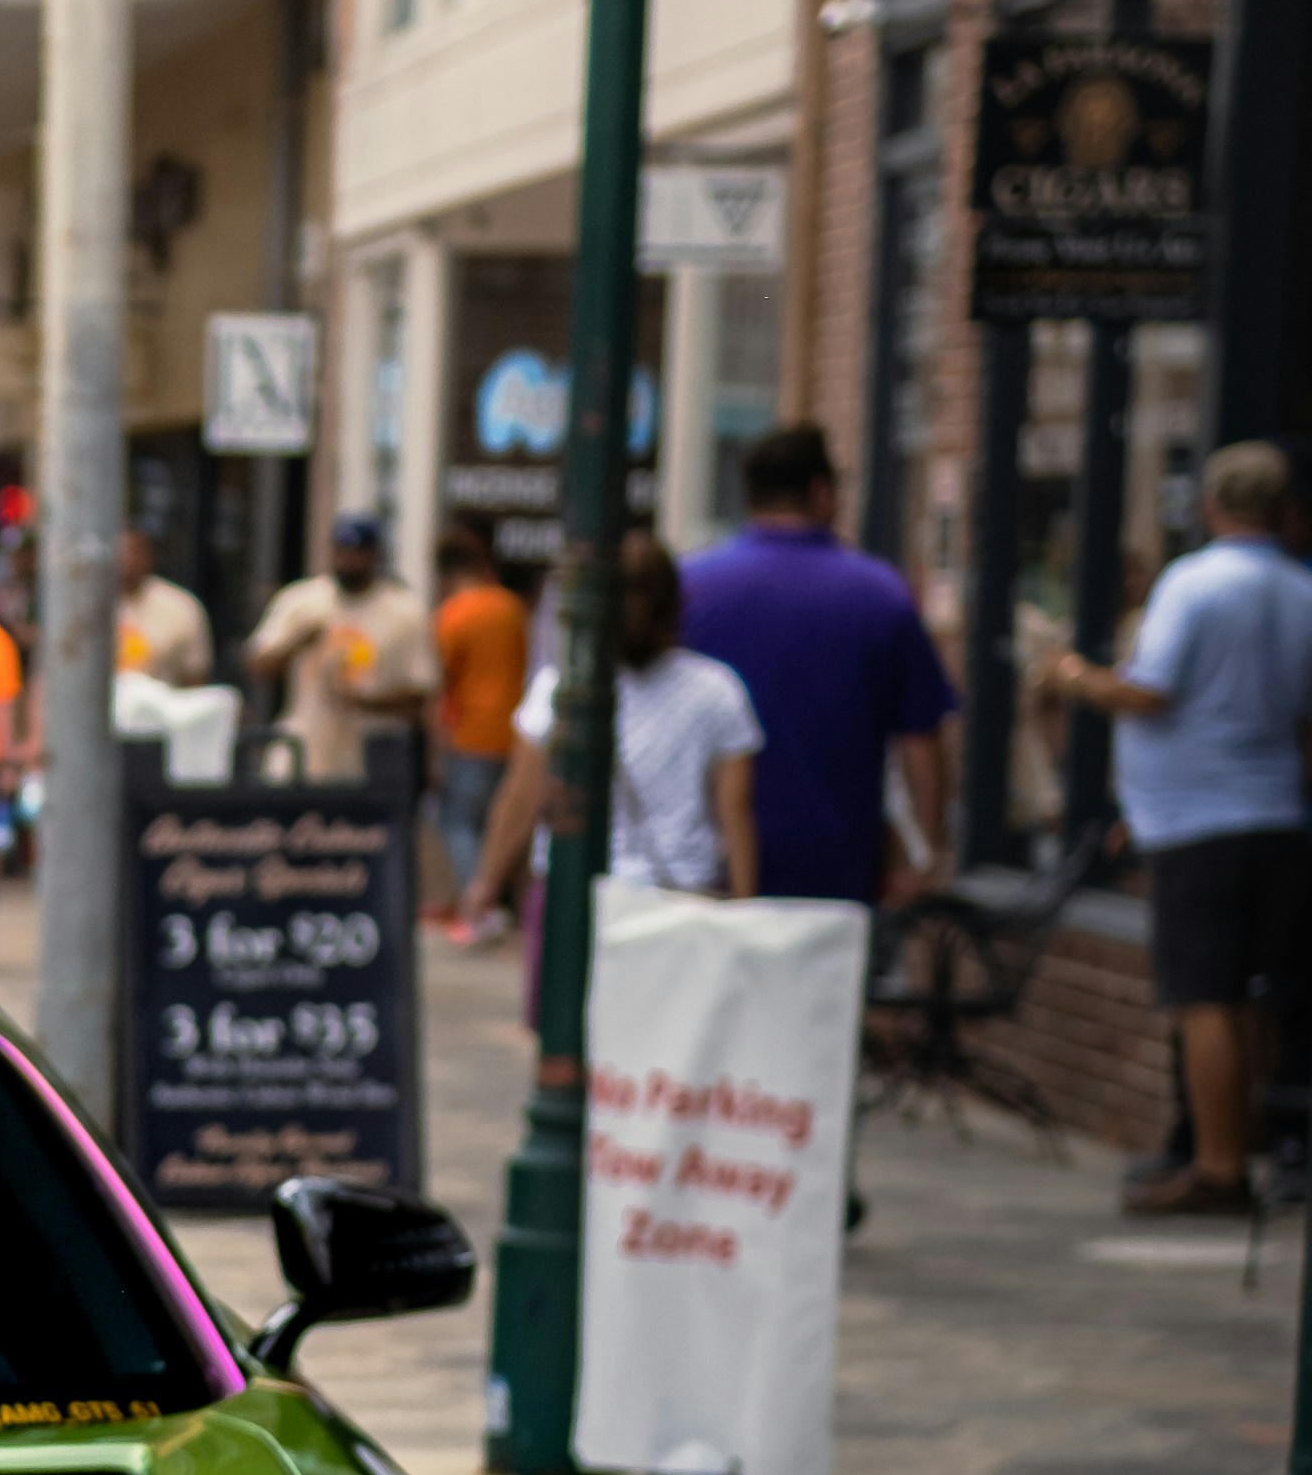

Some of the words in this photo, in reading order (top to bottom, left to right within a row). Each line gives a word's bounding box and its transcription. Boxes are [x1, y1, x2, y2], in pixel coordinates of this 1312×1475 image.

[163, 914, 197, 968] 3
[206, 911, 283, 965] for
[164, 1004, 199, 1059] 3
[208, 1001, 284, 1057] for
[644, 1067, 813, 1149] Parking
[675, 1142, 796, 1218] Away
[618, 1206, 740, 1267] Zone
